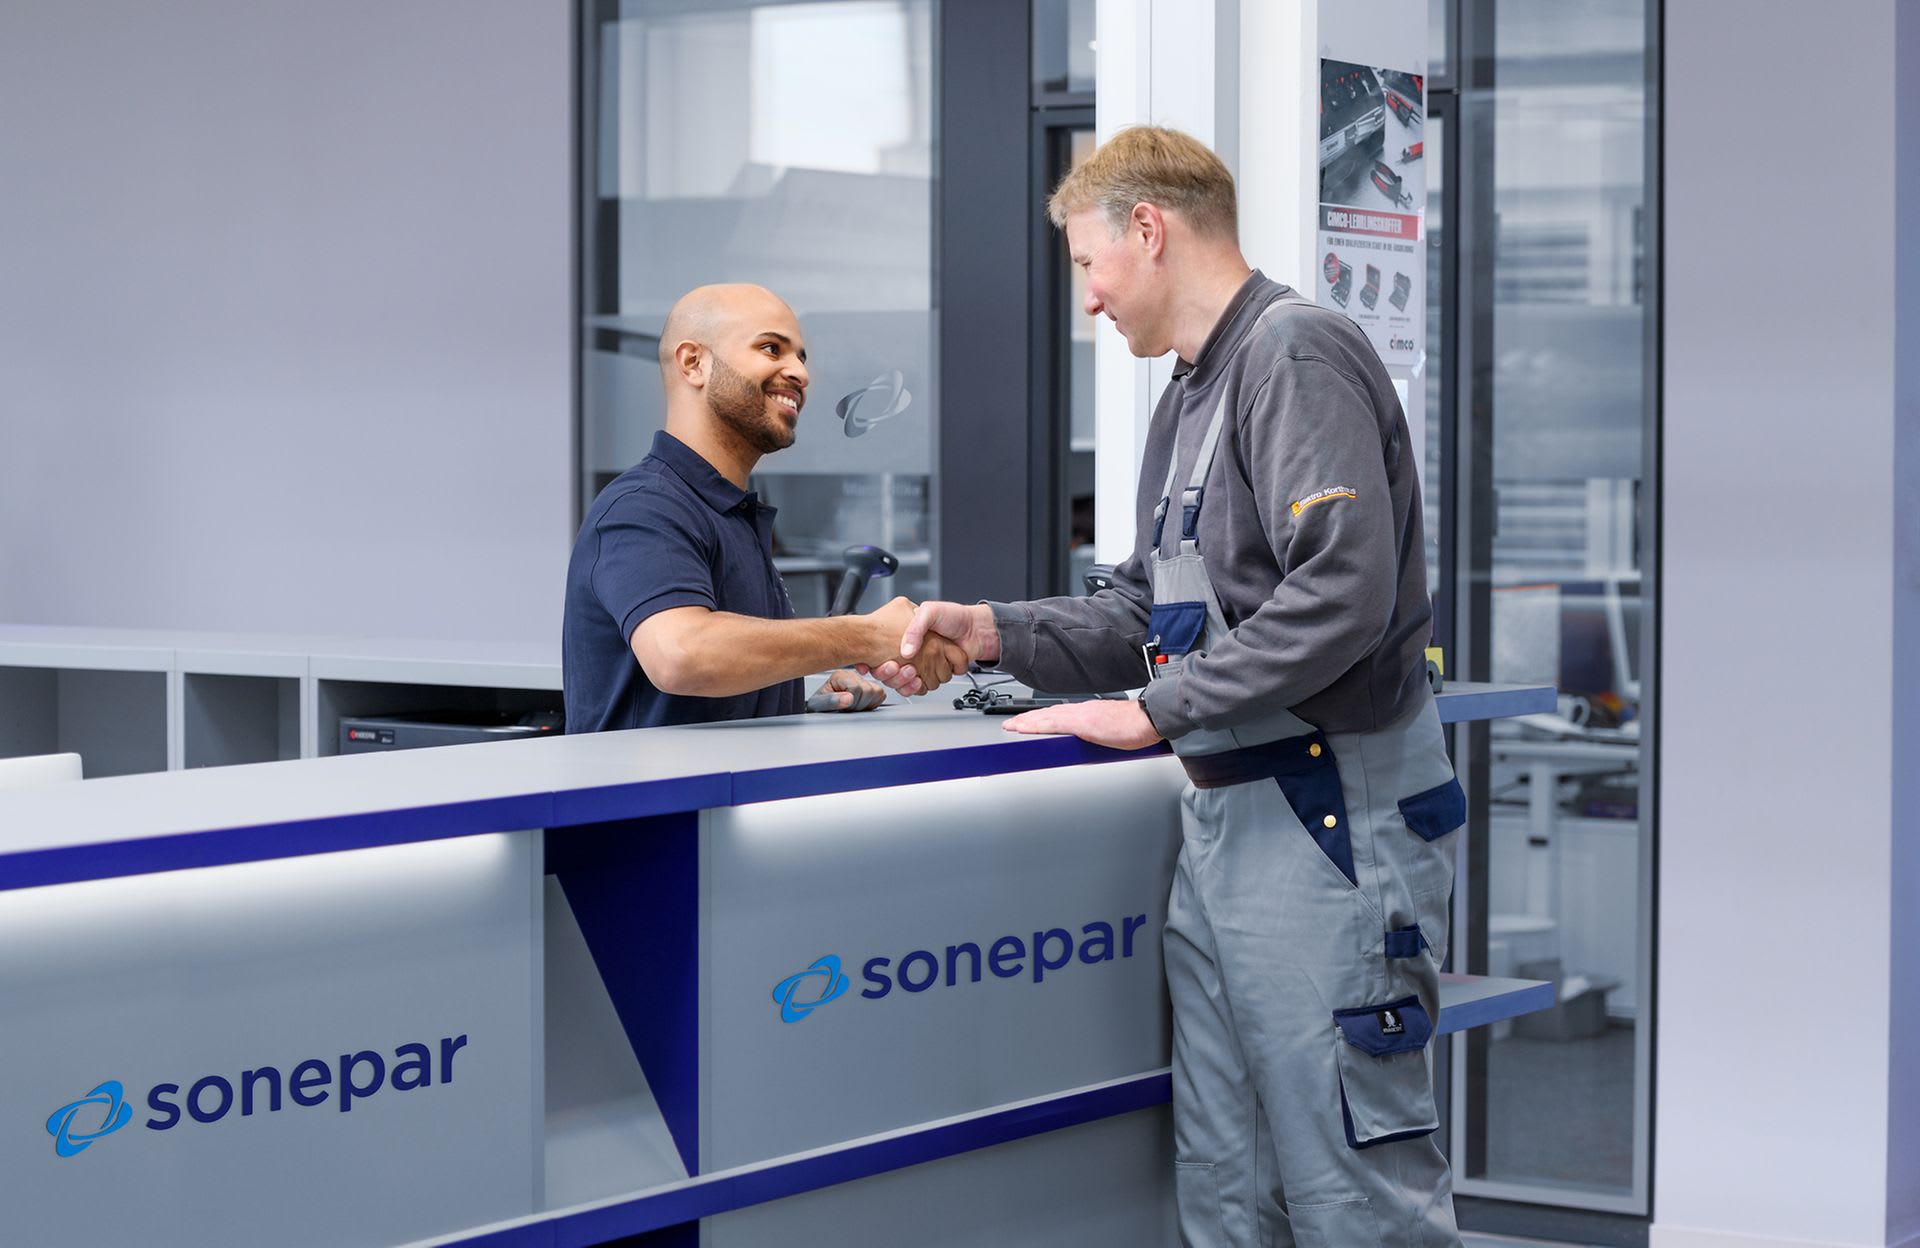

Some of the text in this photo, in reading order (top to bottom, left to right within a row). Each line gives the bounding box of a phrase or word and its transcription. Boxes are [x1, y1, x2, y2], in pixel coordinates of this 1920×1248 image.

[1389, 334, 1414, 350] cimco
[861, 913, 1147, 1000] sonepar
[145, 1034, 468, 1131] sonepar
